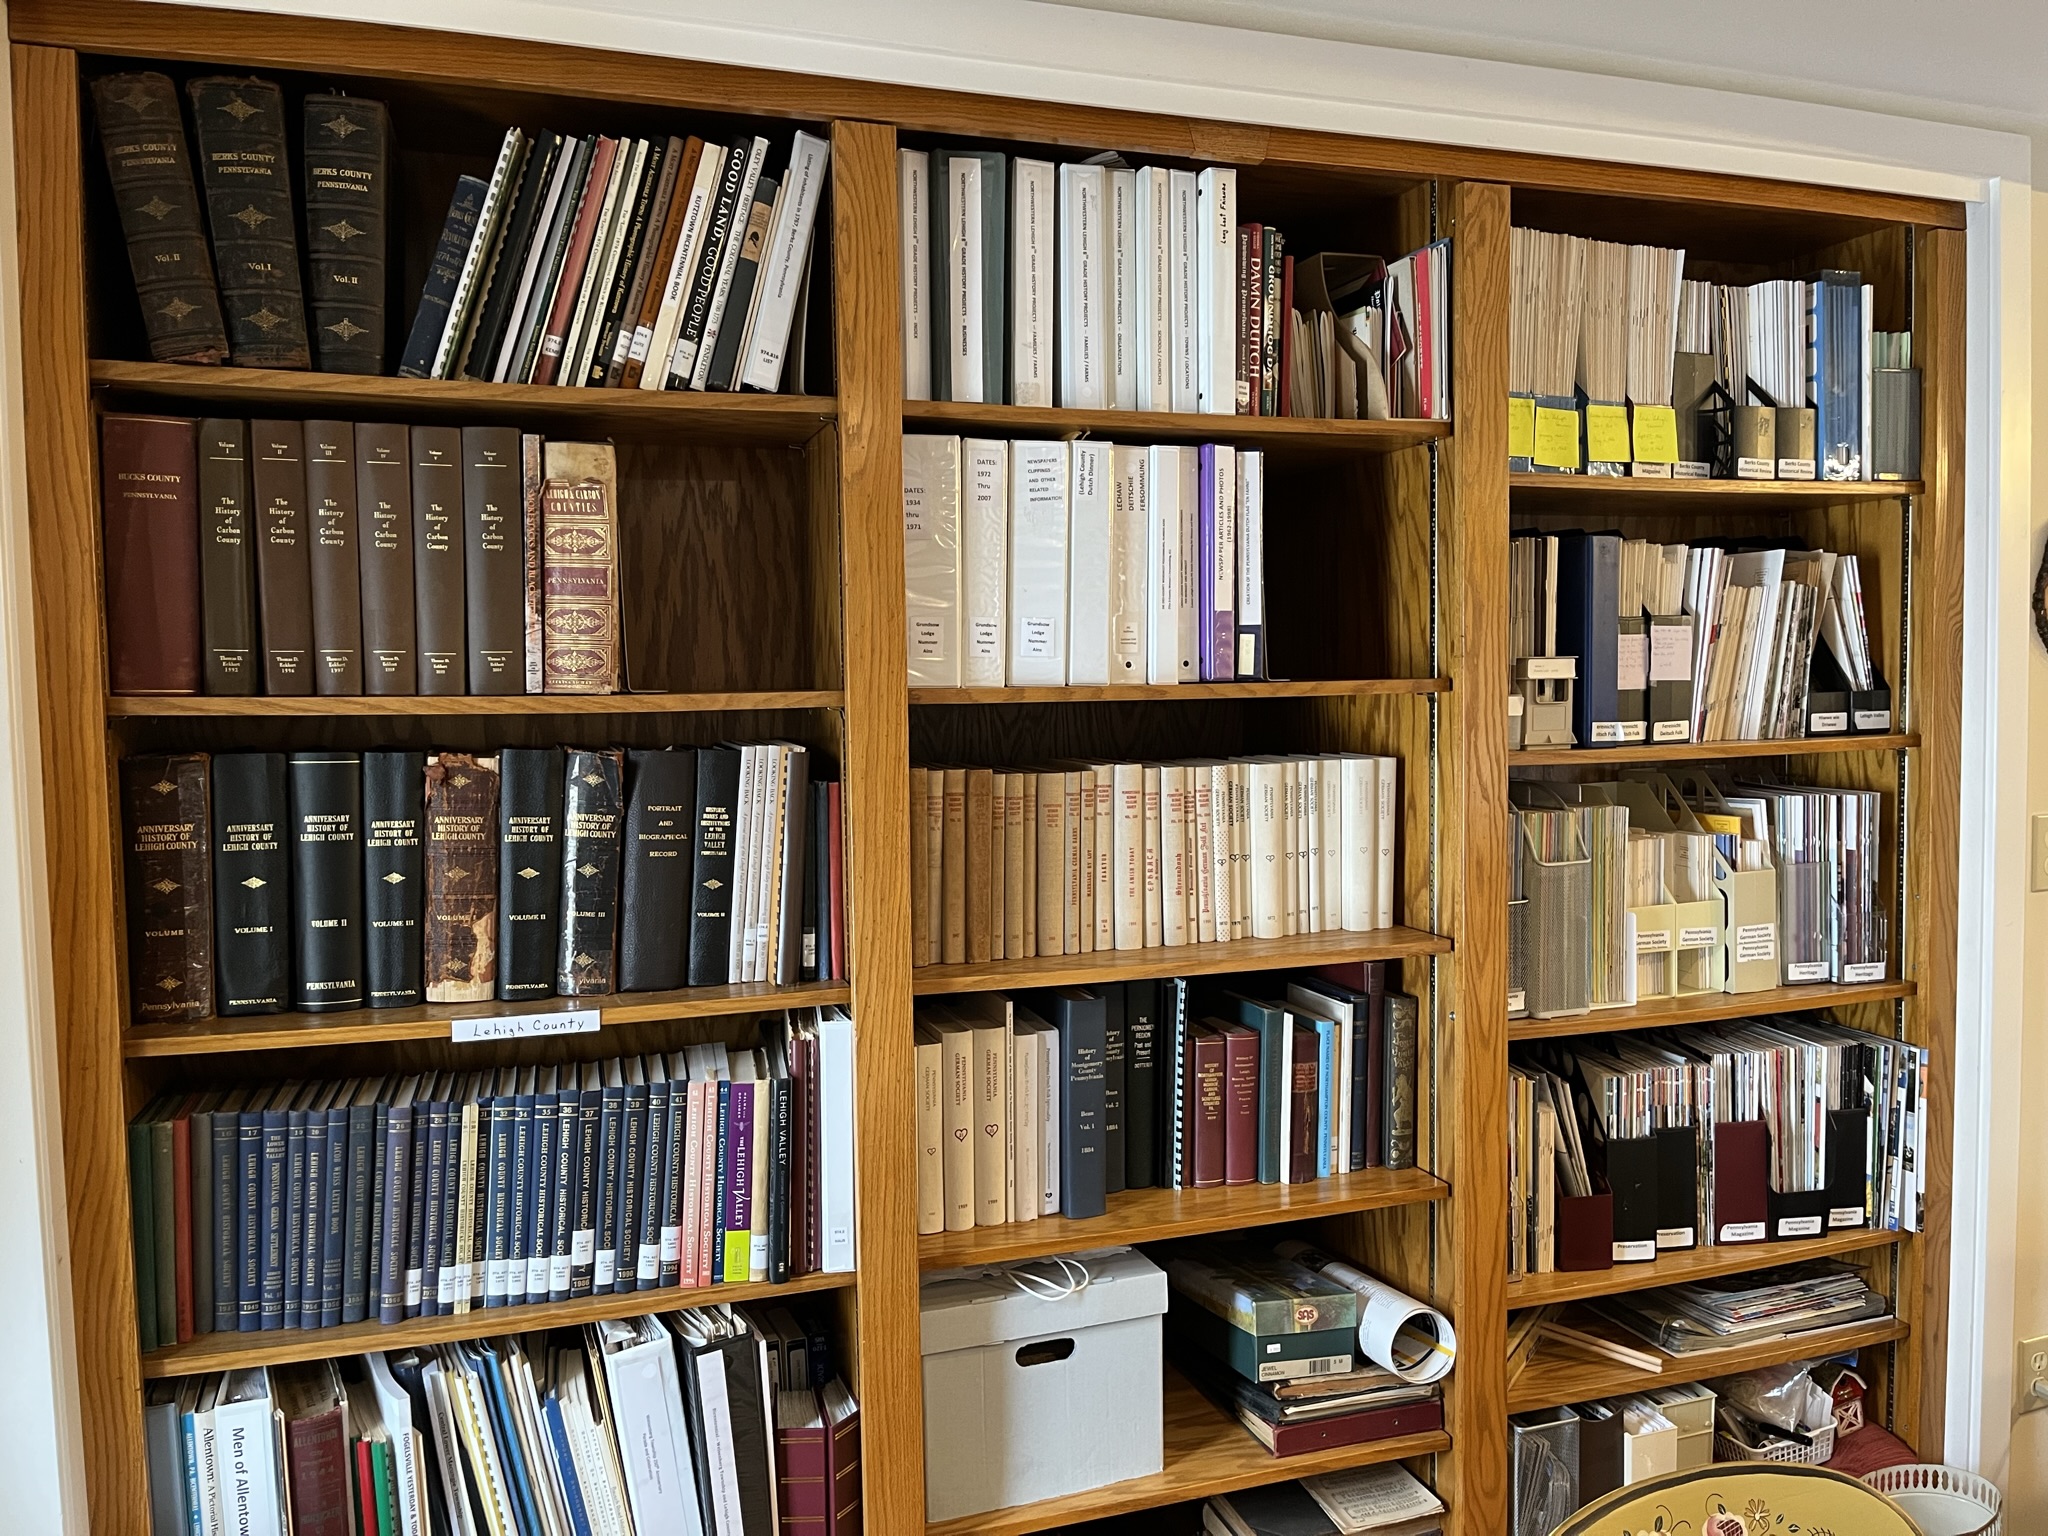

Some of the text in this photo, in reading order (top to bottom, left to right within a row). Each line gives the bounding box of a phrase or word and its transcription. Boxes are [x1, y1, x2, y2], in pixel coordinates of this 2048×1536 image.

[241, 153, 275, 163] COUNTY
[805, 154, 813, 170] Listing
[218, 167, 272, 175] PENNSYLVANIA
[340, 169, 372, 180] COUNTY
[317, 181, 368, 191] PENNSYLVANIA
[797, 179, 806, 207] inhabitants
[792, 213, 800, 227] 1767,
[686, 148, 744, 336] GOOD LAND, GOOD PEOPLE
[669, 195, 702, 301] KUTZTOWN BICENTENNIAL BOOK
[778, 266, 789, 298] Pennsylvania
[1250, 258, 1261, 378] DAMN DUTCH
[1266, 265, 1276, 383] GROUNDHOG DAY
[119, 473, 181, 483] BUCKS COUNTY
[124, 492, 177, 500] PENNSYLVANIA
[222, 497, 234, 505] The
[215, 507, 241, 516] History
[481, 514, 503, 523] History
[216, 536, 241, 545] County
[483, 543, 503, 551] County
[548, 578, 604, 586] PENNSYLVANIA
[304, 815, 349, 823] ANNIVERSARY
[509, 817, 551, 825] ANNIVERSARY
[307, 823, 348, 832] HISTORY OF
[512, 825, 549, 834] HISTORY OF
[328, 833, 354, 841] COUNTY
[504, 834, 553, 842] LEHIGH COUNTY
[311, 920, 338, 928] VOLUME
[1743, 926, 1769, 934] Pennsylvania
[306, 980, 355, 990] PENNSYLVANIA
[473, 1017, 585, 1037] Lehigh County
[1071, 1061, 1103, 1069] Montgomery
[778, 1090, 787, 1166] LEHIGH VALLEY
[736, 1147, 745, 1188] LEHIGH
[558, 1119, 570, 1236] LEHIGH COUNTY HISTORICAL
[623, 1117, 638, 1262] LEHIGH COUNTY HISTORICAL SOCIETY
[732, 1188, 750, 1227] VALLEY
[1727, 1224, 1758, 1232] Pennsylvania
[618, 1270, 634, 1278] 1990
[203, 1428, 214, 1483] Allentown:
[403, 1433, 412, 1474] FOGELSVILLE
[232, 1428, 249, 1536] Men of Allentow
[407, 1476, 416, 1512] YESTERDAY
[208, 1492, 216, 1519] Pictorial
